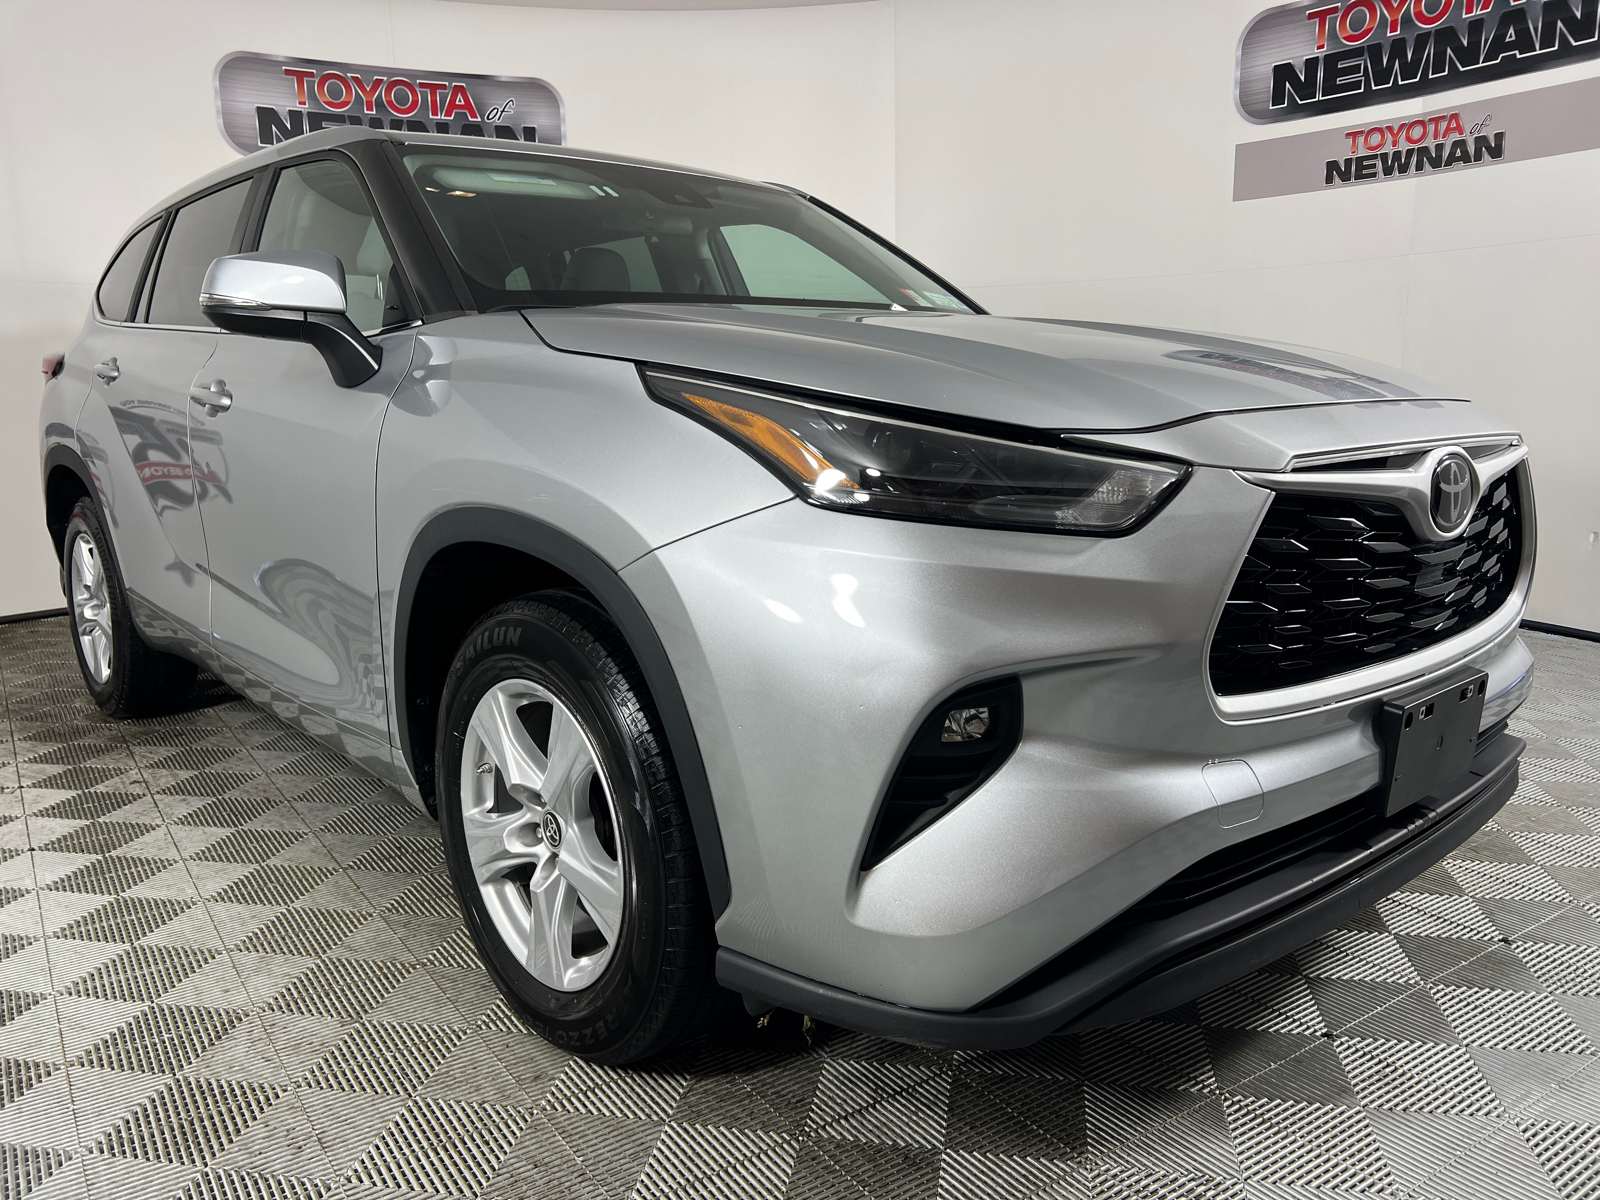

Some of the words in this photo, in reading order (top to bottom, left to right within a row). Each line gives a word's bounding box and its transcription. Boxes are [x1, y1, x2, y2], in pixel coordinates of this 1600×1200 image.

[1269, 0, 1600, 109] NEWNAN
[282, 66, 482, 121] TOYOTA
[485, 99, 515, 122] of
[1324, 130, 1507, 186] NEWNAN
[1345, 112, 1466, 155] TOYOTA
[1469, 113, 1493, 136] of
[456, 626, 523, 677] SAILUN
